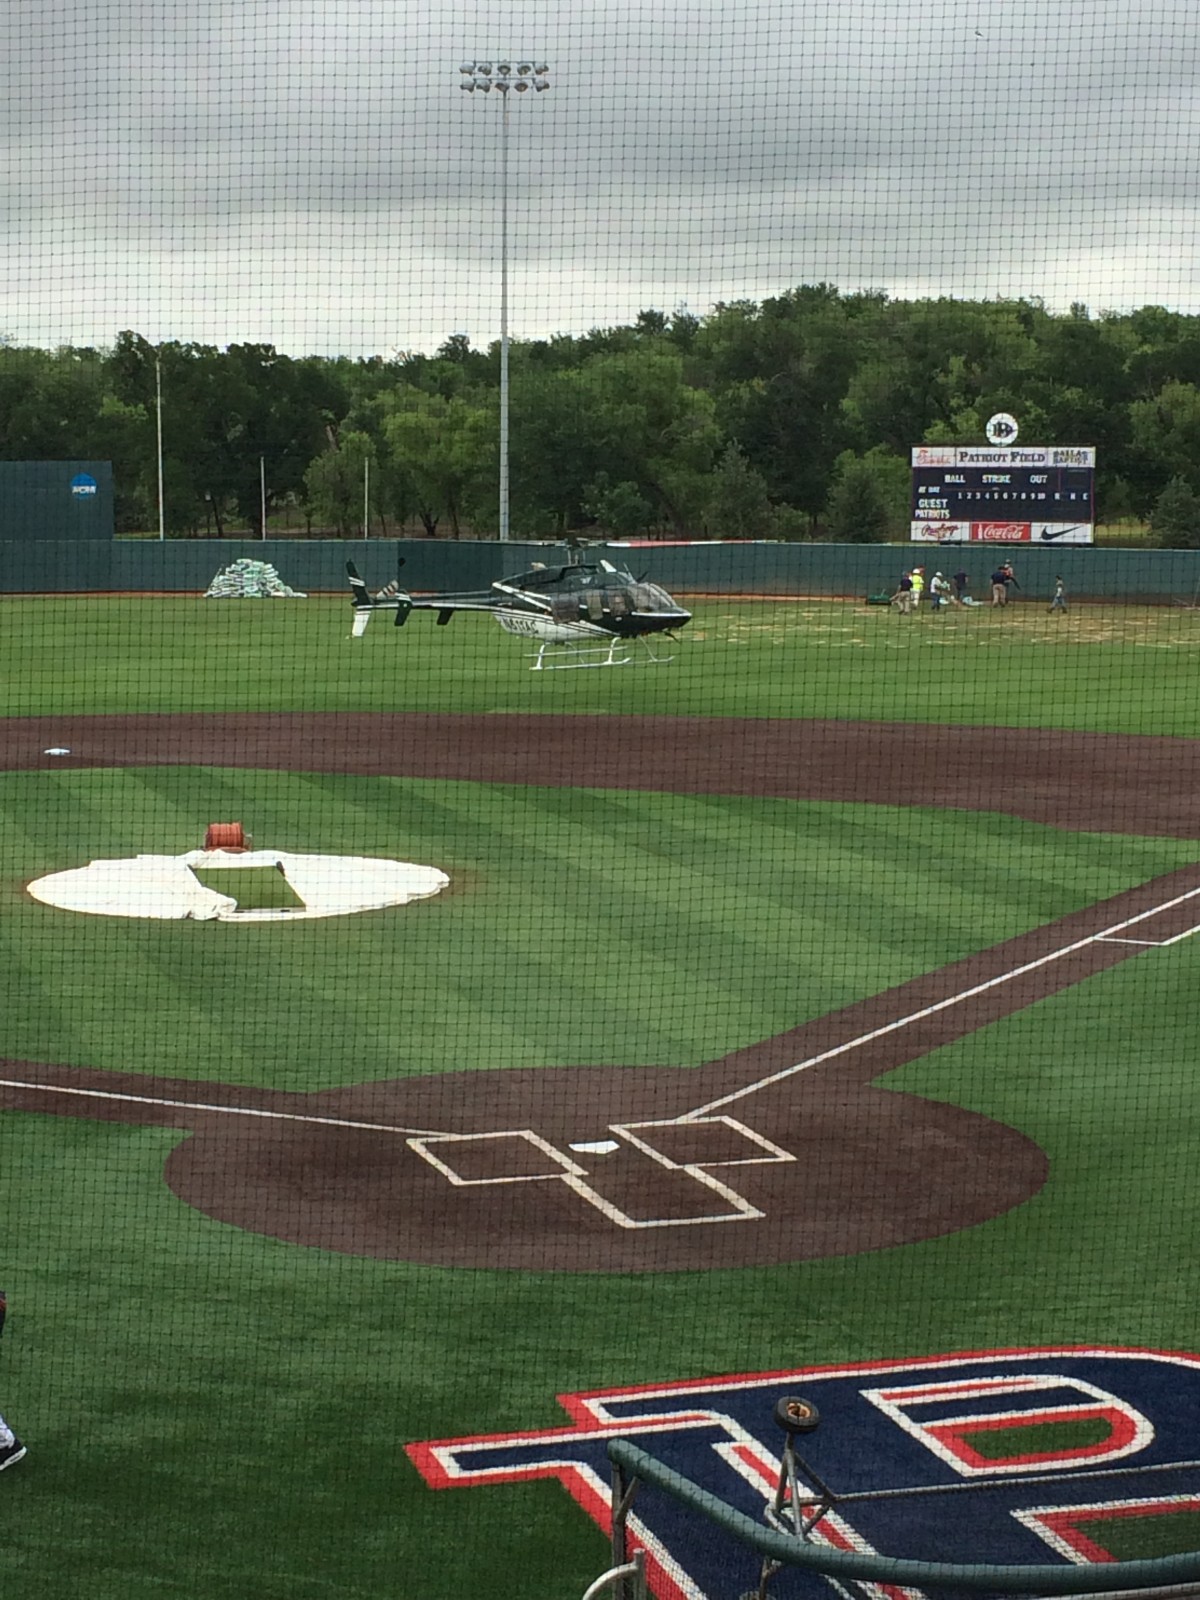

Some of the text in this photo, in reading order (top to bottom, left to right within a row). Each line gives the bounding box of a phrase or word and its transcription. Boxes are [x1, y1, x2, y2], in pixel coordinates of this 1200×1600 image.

[1010, 451, 1046, 463] FIELD
[944, 474, 1048, 484] BALL STRIKE OUT
[918, 498, 948, 509] GUEST
